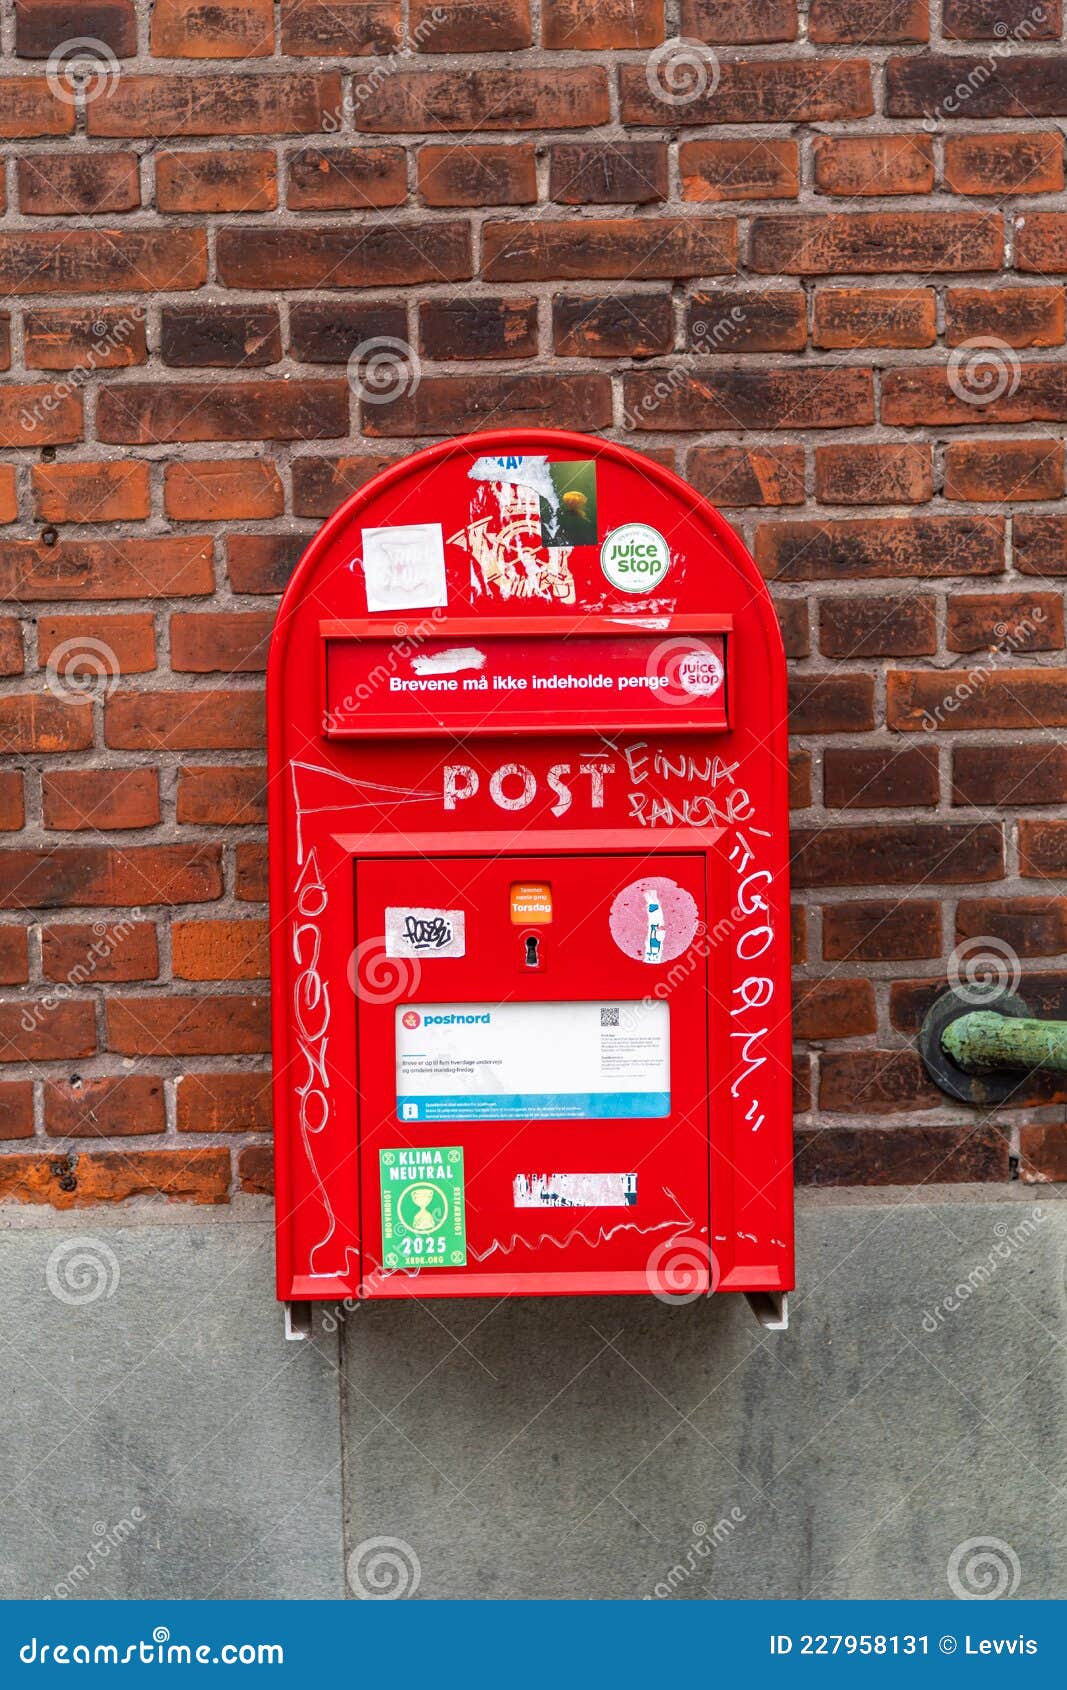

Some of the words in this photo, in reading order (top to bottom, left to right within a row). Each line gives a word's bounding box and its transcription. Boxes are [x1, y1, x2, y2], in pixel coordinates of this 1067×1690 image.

[611, 539, 657, 560] juice
[618, 558, 662, 575] stop
[682, 661, 718, 675] juice
[390, 677, 458, 691] Brevene
[463, 675, 488, 690] må
[493, 676, 527, 690] ikke
[532, 674, 613, 689] indeholde
[618, 676, 669, 690] penge
[688, 673, 719, 686] stop
[443, 763, 615, 818] POST
[512, 903, 552, 912] Torsdag
[424, 1013, 491, 1027] postnord
[399, 1151, 443, 1165] KLIMA
[390, 1166, 453, 1180] NEUTRAL
[402, 1237, 446, 1254] 2025
[405, 1256, 444, 1265] XRDK.ORG
